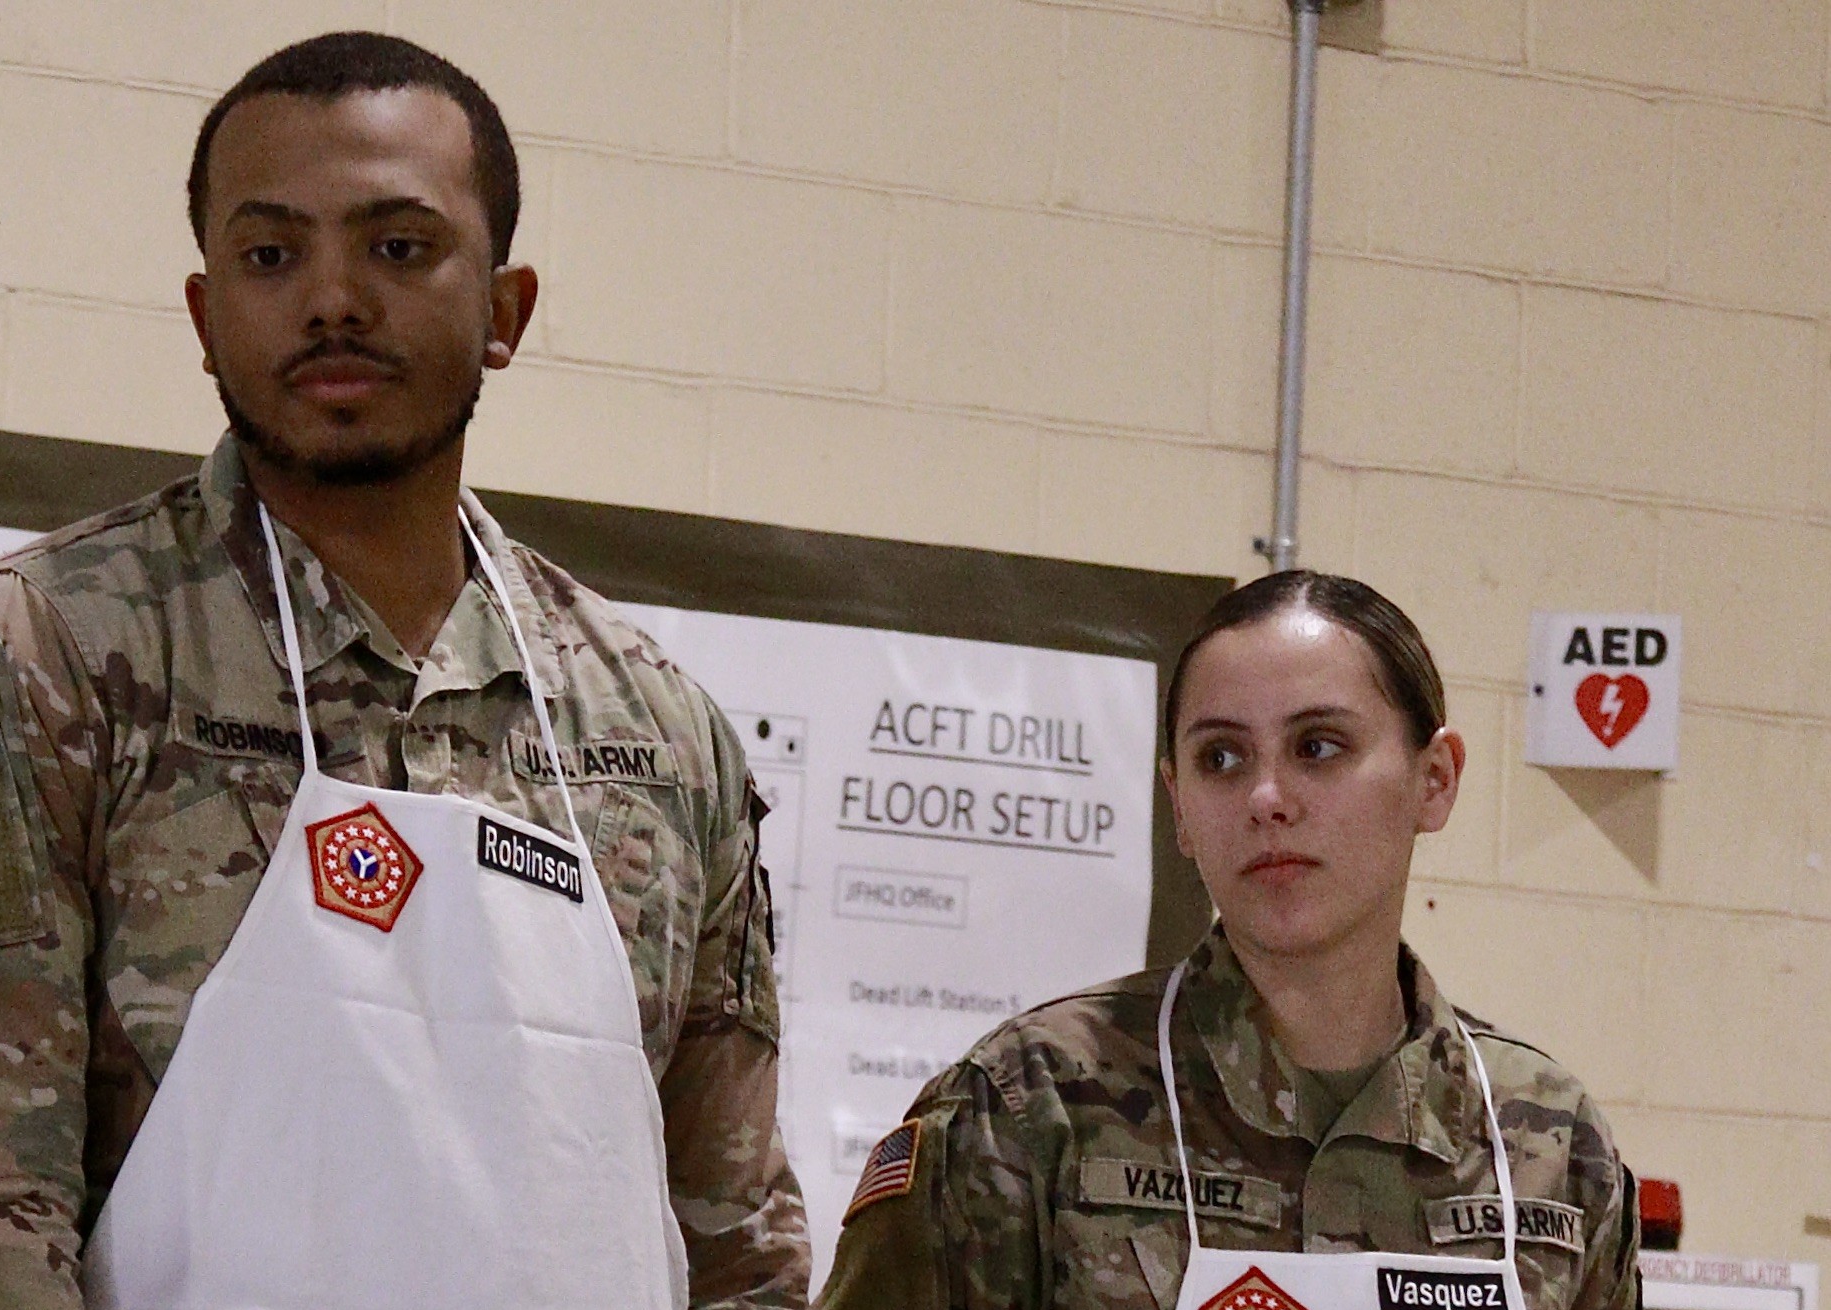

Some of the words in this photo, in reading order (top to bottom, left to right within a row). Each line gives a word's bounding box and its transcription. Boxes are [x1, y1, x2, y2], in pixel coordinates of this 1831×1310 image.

[1563, 626, 1668, 668] AED
[194, 713, 329, 760] ROBINSO
[870, 699, 974, 750] ACFT
[988, 711, 1092, 766] DRILL
[583, 744, 658, 778] ARMY
[840, 775, 976, 833] FLOOR
[988, 791, 1116, 845] SETUP
[484, 824, 581, 896] Robinson
[898, 884, 957, 912] Office
[1451, 1203, 1507, 1236] U.S
[1517, 1206, 1576, 1243] ARMY
